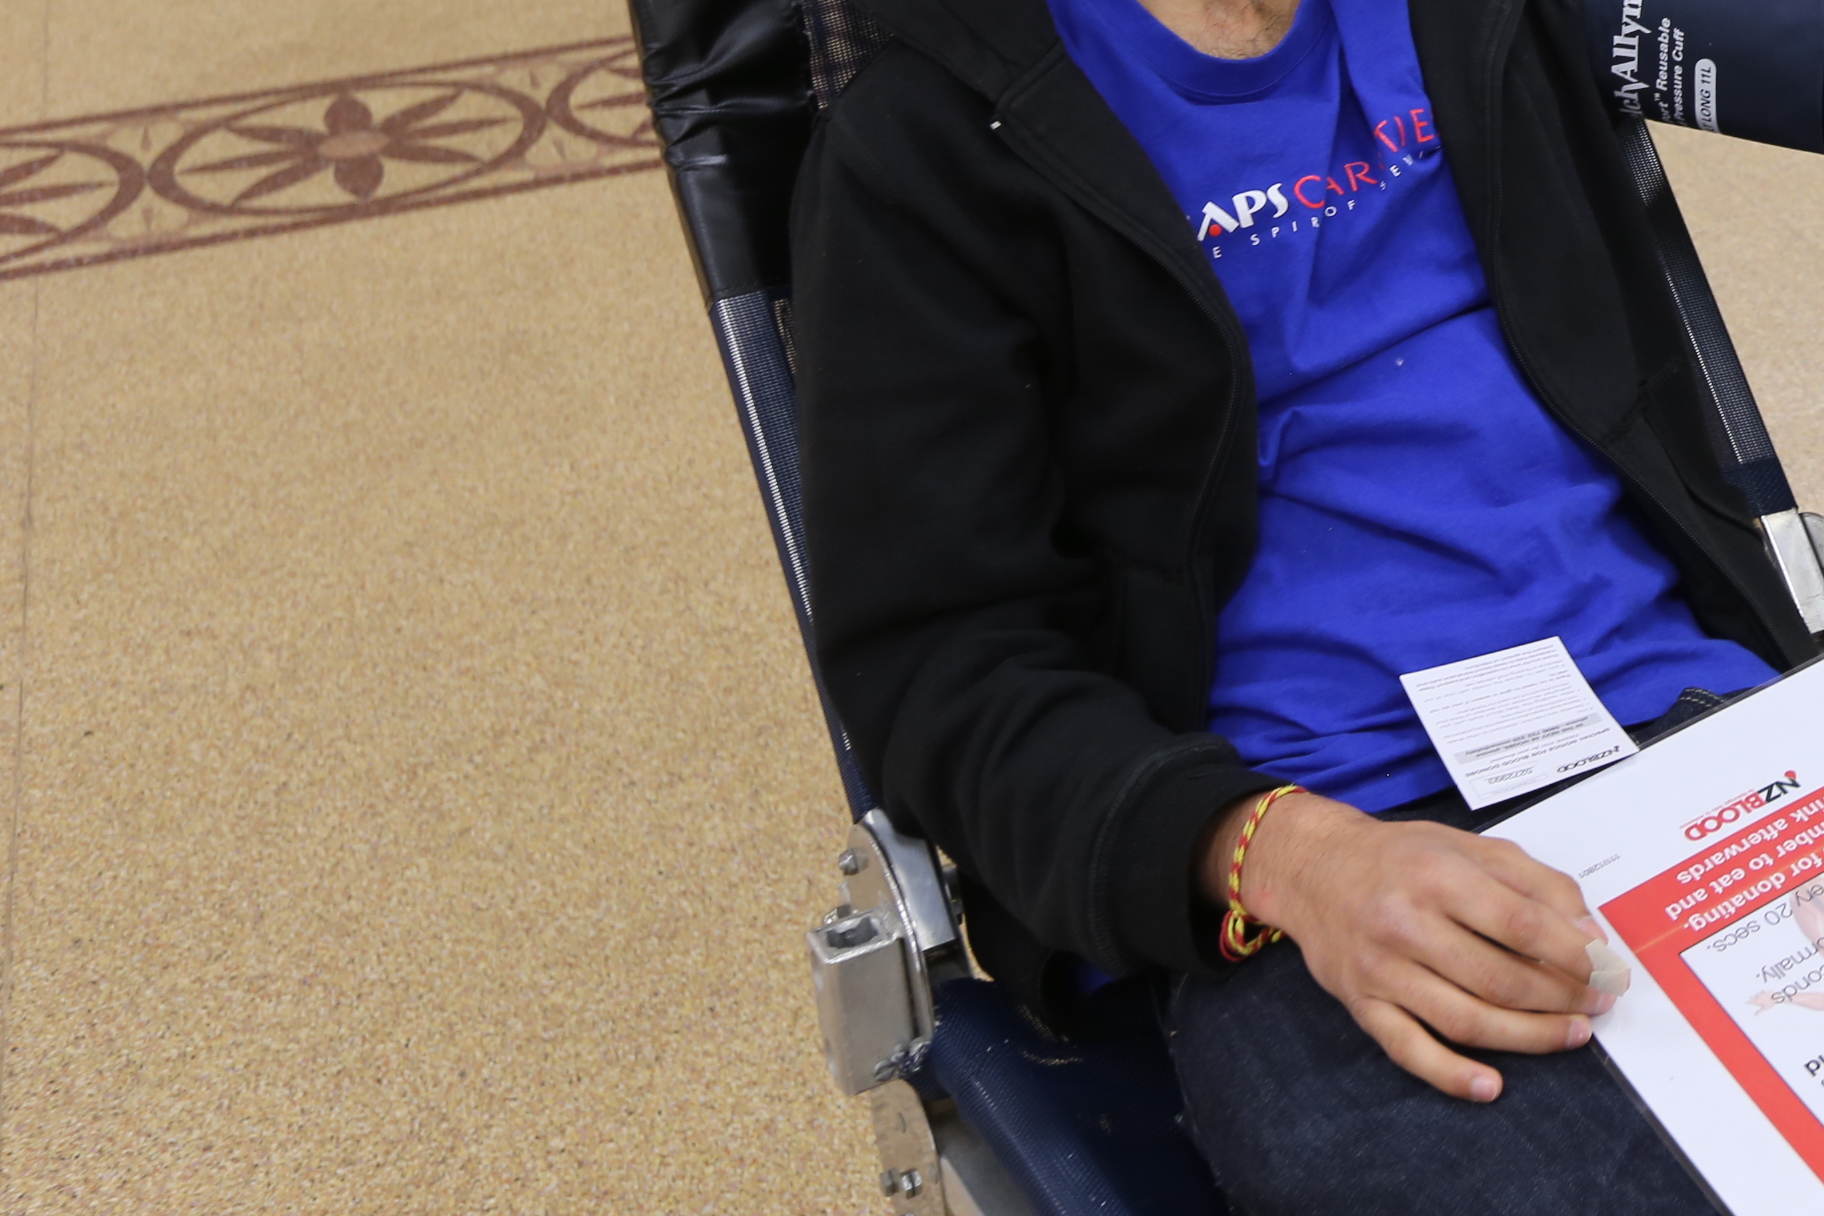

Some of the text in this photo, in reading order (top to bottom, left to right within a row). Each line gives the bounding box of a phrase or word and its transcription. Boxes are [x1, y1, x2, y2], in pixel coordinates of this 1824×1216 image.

[1655, 17, 1671, 92] Reusable
[1672, 28, 1685, 61] Cuff
[1197, 183, 1289, 241] APS
[1685, 770, 1800, 841] NZBLOOD
[1677, 818, 1788, 883] afterwards
[1749, 853, 1774, 870] to
[1790, 852, 1822, 876] for
[1709, 868, 1745, 894] eat
[1665, 888, 1708, 920] and
[1683, 872, 1786, 931] donating.
[1761, 899, 1794, 927] 20
[1704, 916, 1763, 959] secs.
